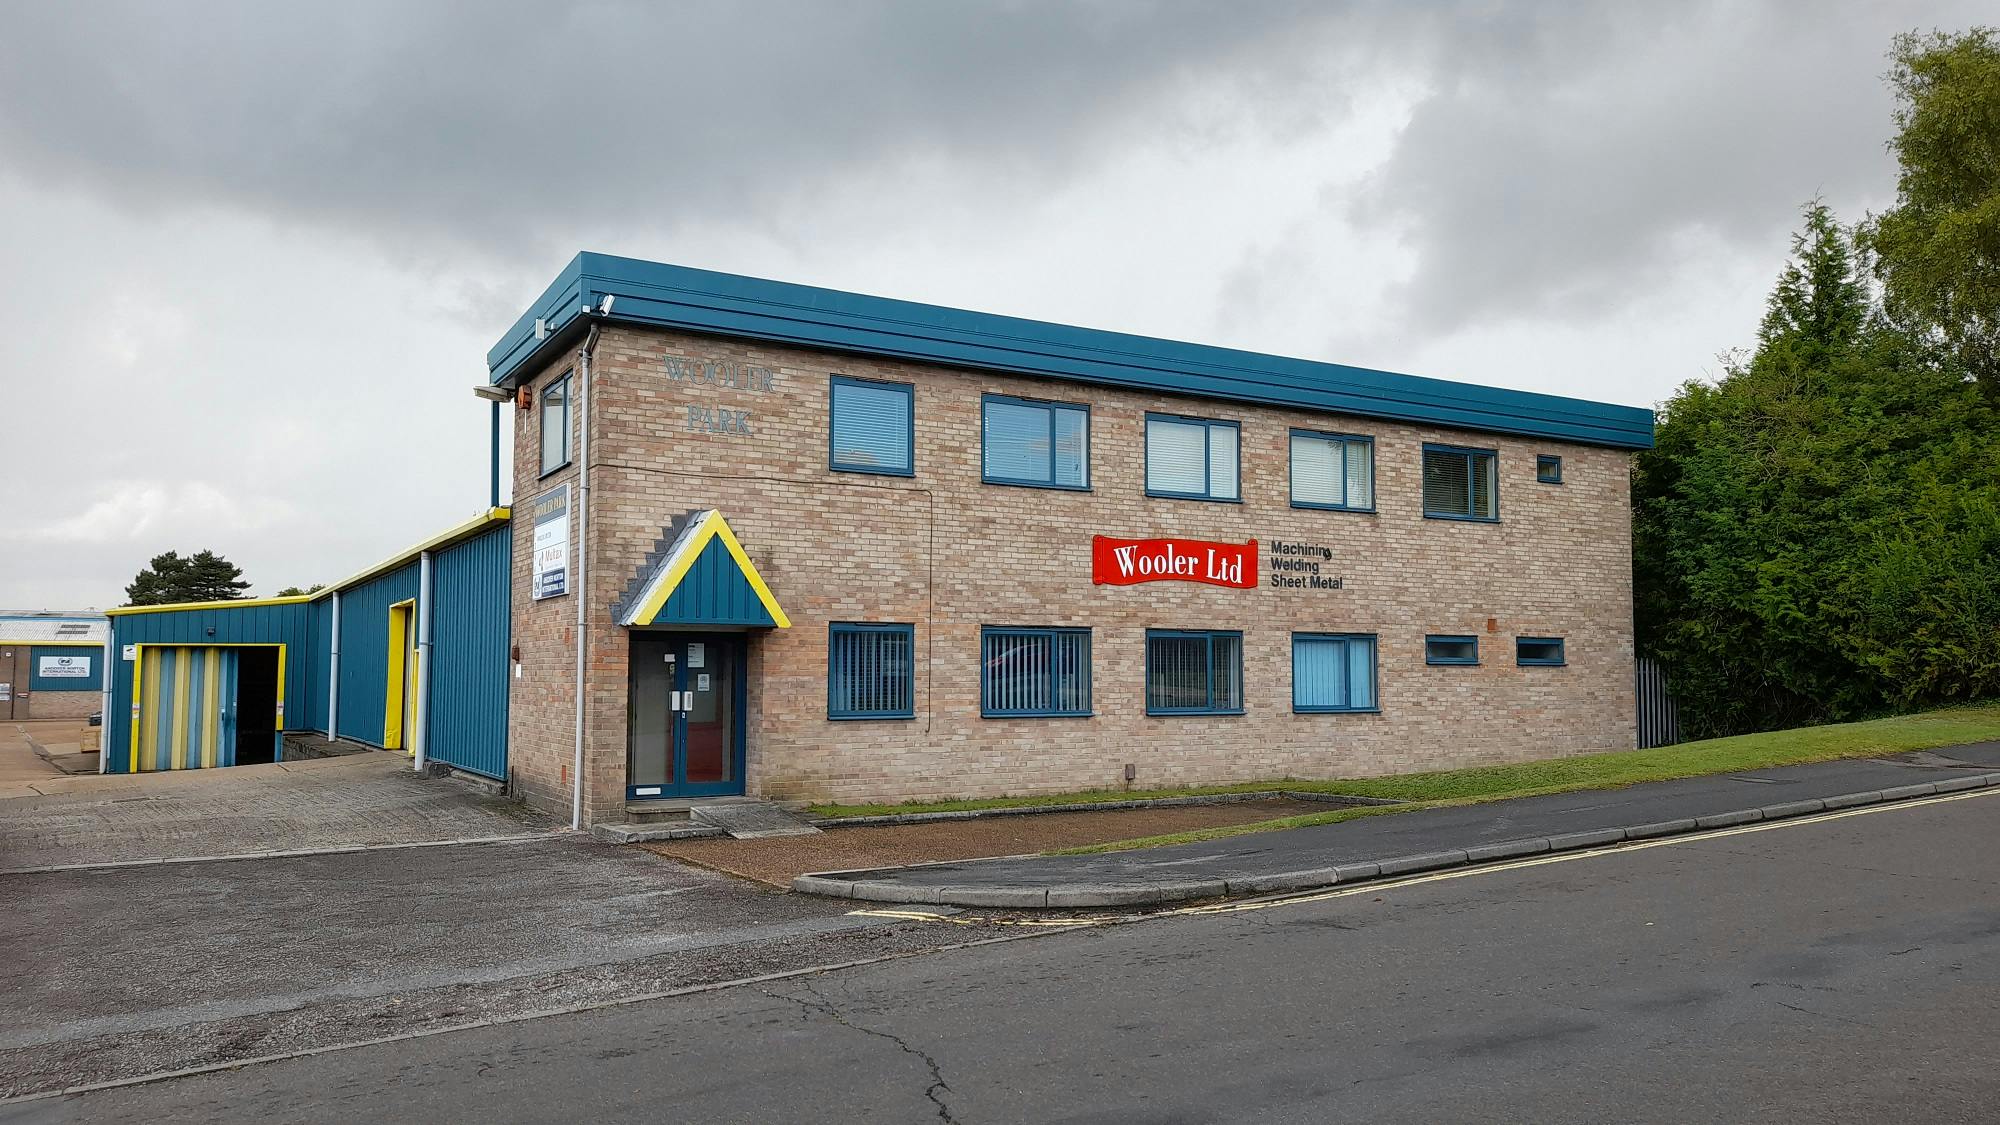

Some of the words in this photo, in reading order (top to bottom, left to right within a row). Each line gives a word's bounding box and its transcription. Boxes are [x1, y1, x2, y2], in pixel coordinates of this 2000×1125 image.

[663, 355, 776, 394] WOOLER
[686, 403, 752, 436] PARK
[1114, 543, 1199, 578] Wooler
[1206, 548, 1243, 584] Ltd
[1271, 541, 1332, 560] Machining
[1271, 557, 1319, 575] Welding
[1271, 574, 1307, 588] Sheet
[1310, 575, 1343, 590] Metal
